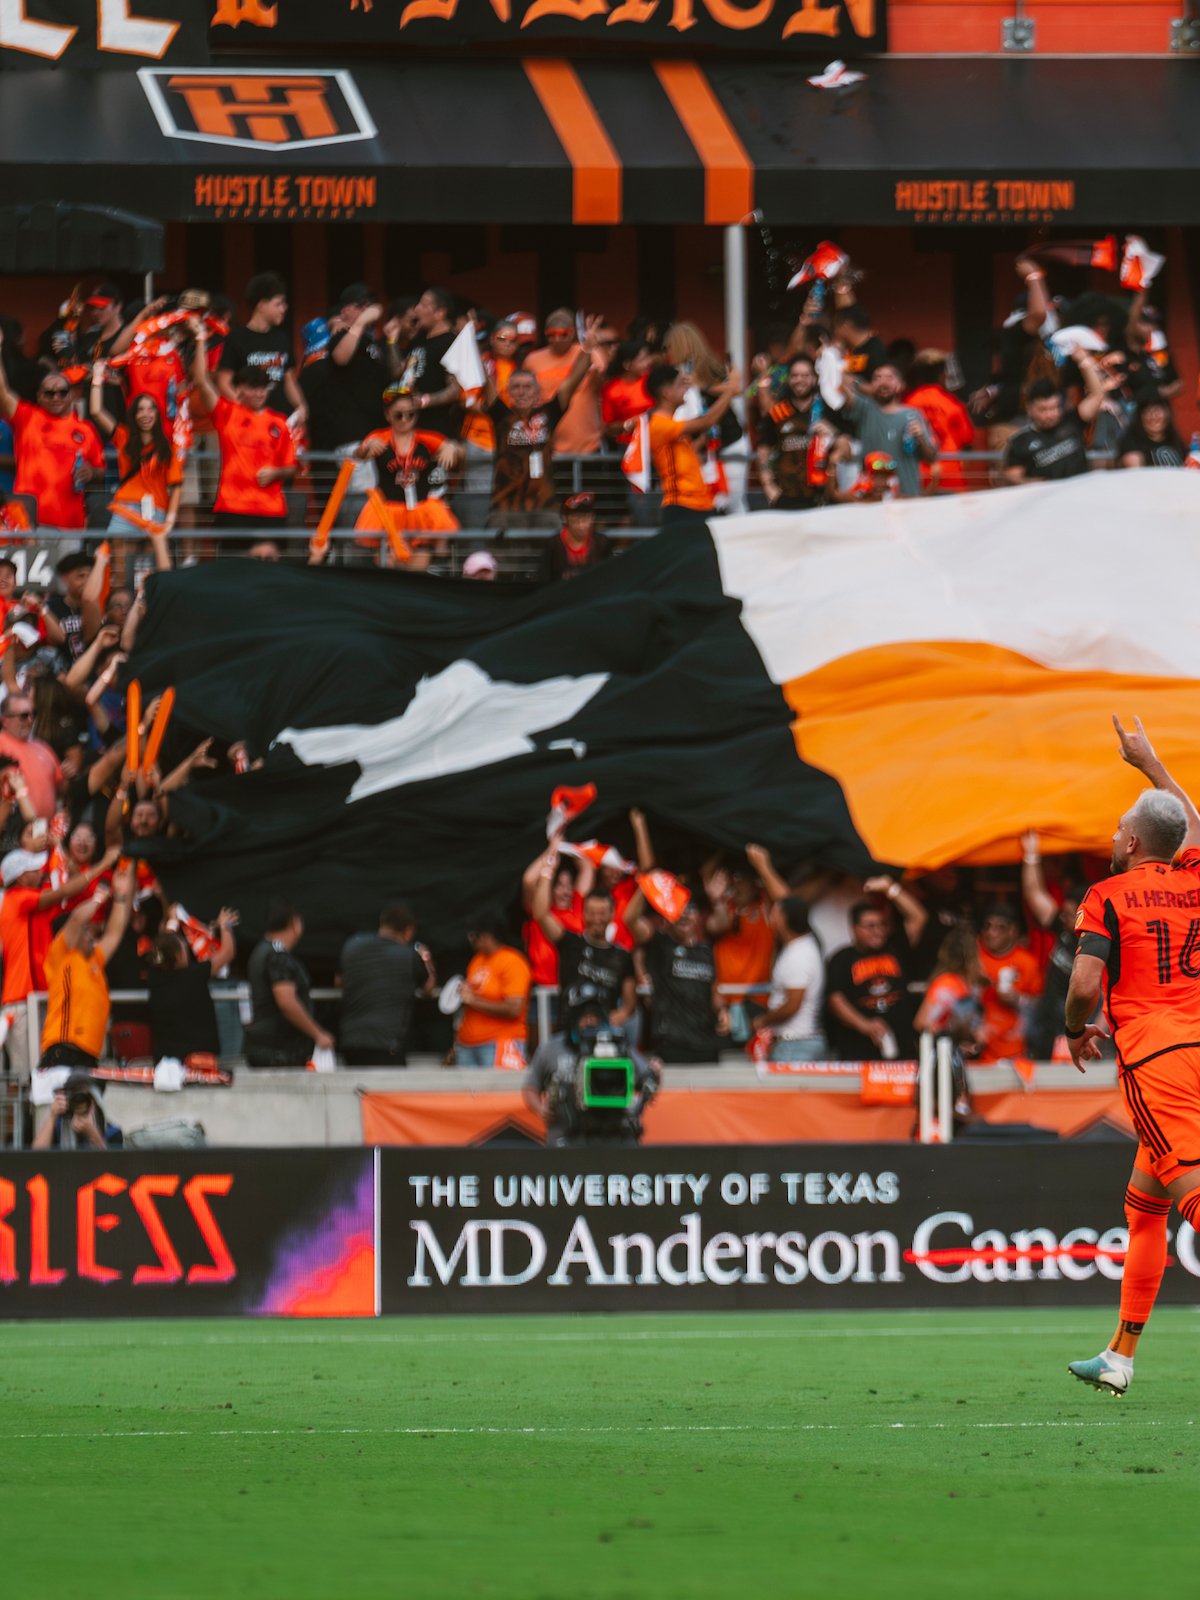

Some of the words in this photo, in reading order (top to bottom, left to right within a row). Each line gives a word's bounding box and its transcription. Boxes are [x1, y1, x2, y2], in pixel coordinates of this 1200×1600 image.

[194, 174, 292, 207] HUSTLE
[294, 174, 378, 207] TOWN
[895, 180, 991, 211] HUSTLE
[992, 180, 1075, 211] TOWN
[0, 549, 53, 587] 14
[1124, 892, 1142, 908] H.
[408, 1174, 480, 1207] THE
[493, 1172, 709, 1207] UNIVERSITY
[721, 1172, 770, 1206] OF
[780, 1171, 900, 1206] TEXAS
[912, 1211, 1173, 1283] Cance
